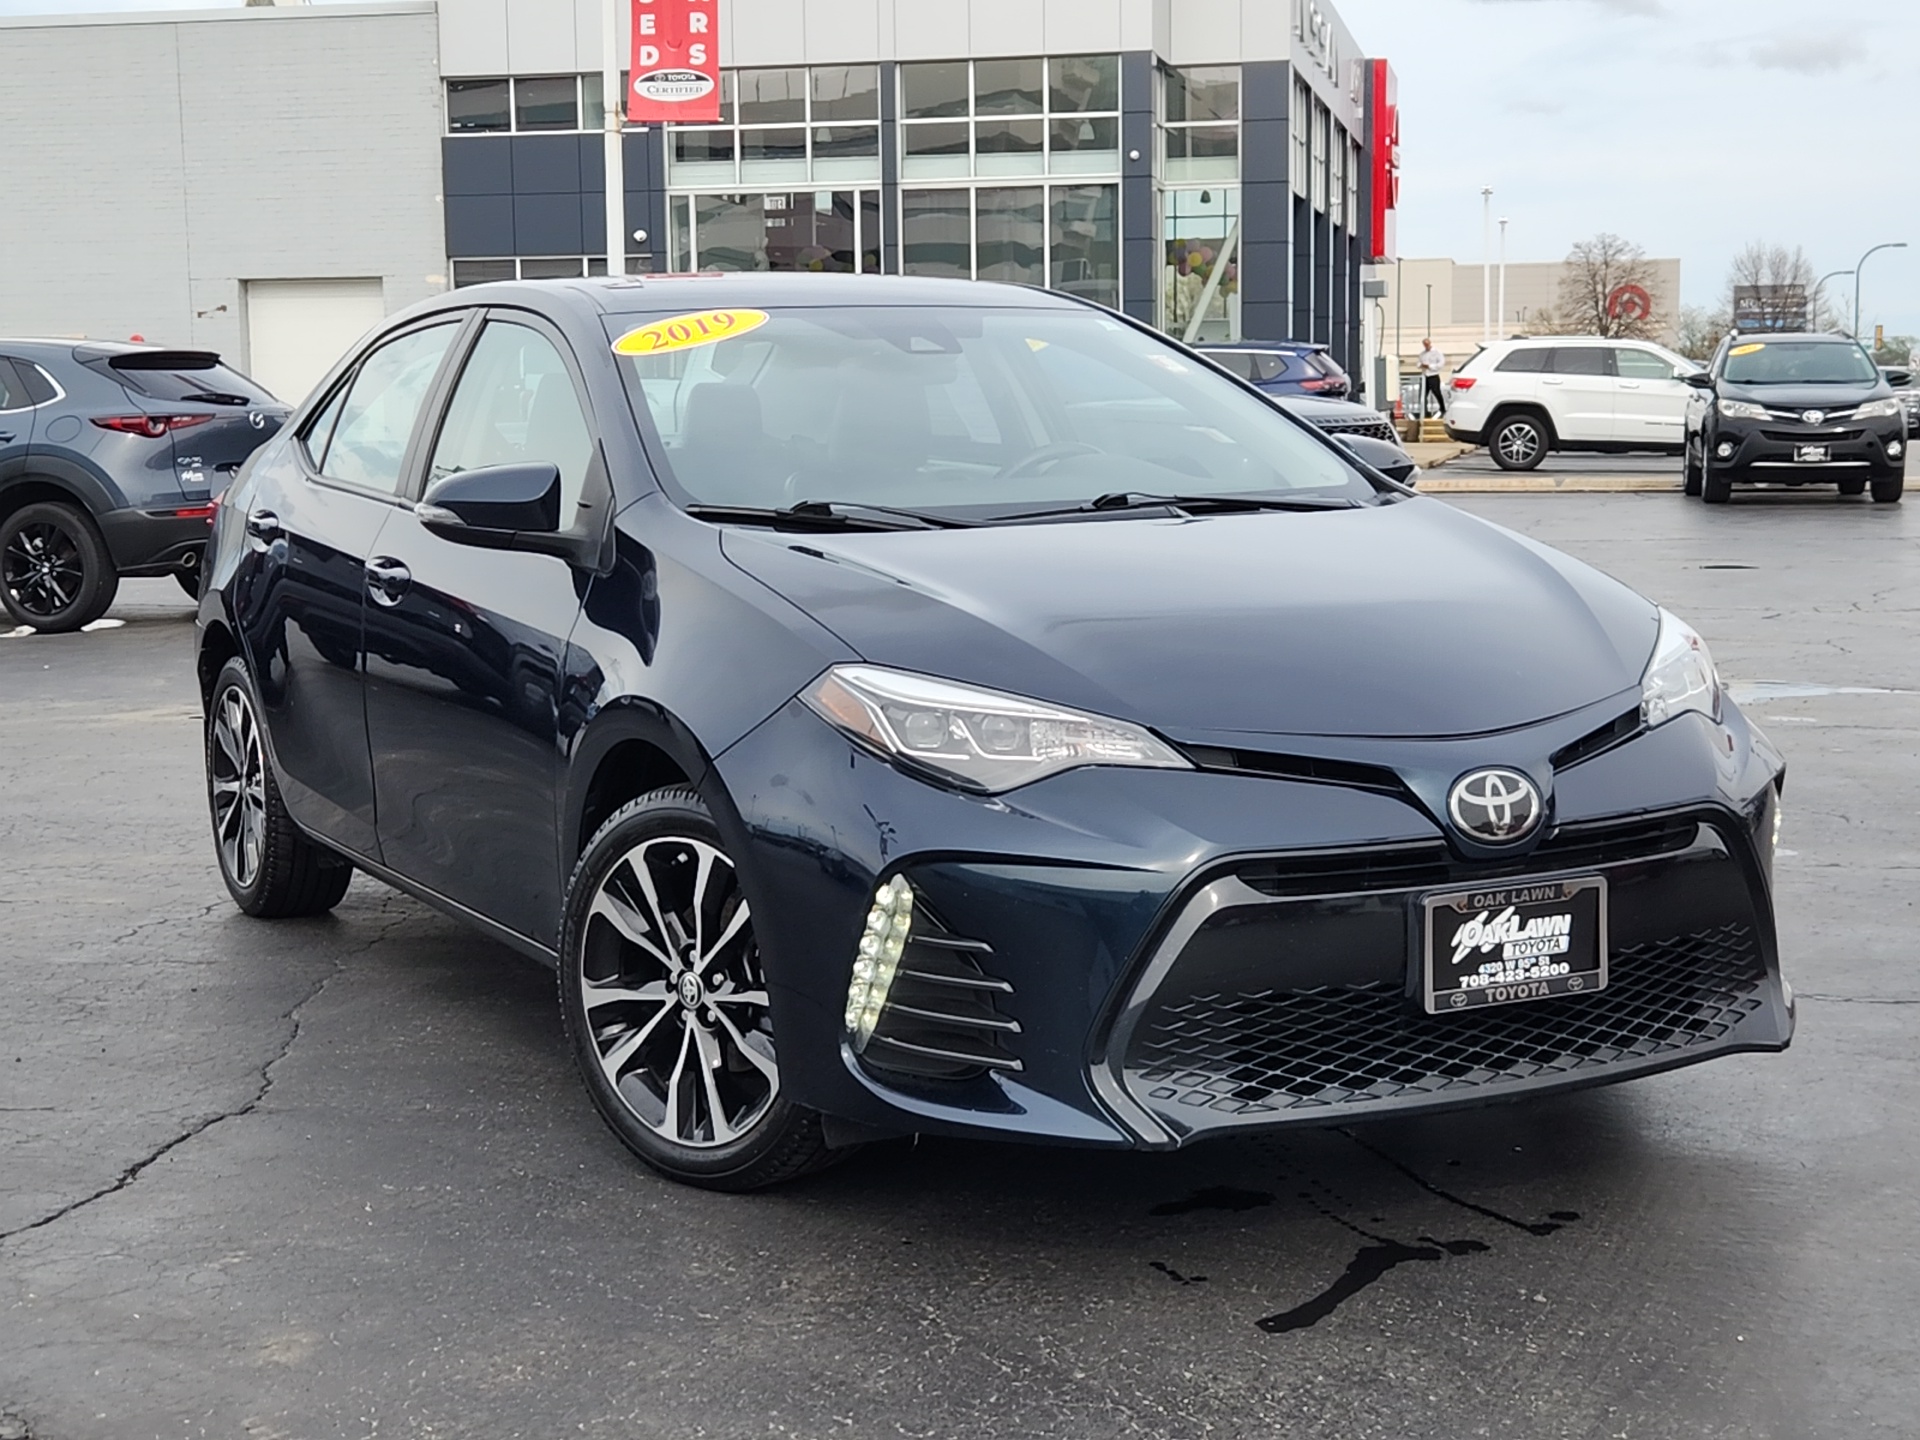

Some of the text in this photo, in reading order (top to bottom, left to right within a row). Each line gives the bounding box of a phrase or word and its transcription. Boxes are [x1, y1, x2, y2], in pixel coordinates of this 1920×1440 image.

[667, 74, 697, 82] TOYOTA
[641, 312, 736, 350] 2019
[1473, 886, 1556, 908] OAK LAWN
[1512, 937, 1561, 954] TOYOTA
[1458, 962, 1571, 989] 708-423-5200
[1484, 981, 1550, 1003] TOYOTA
